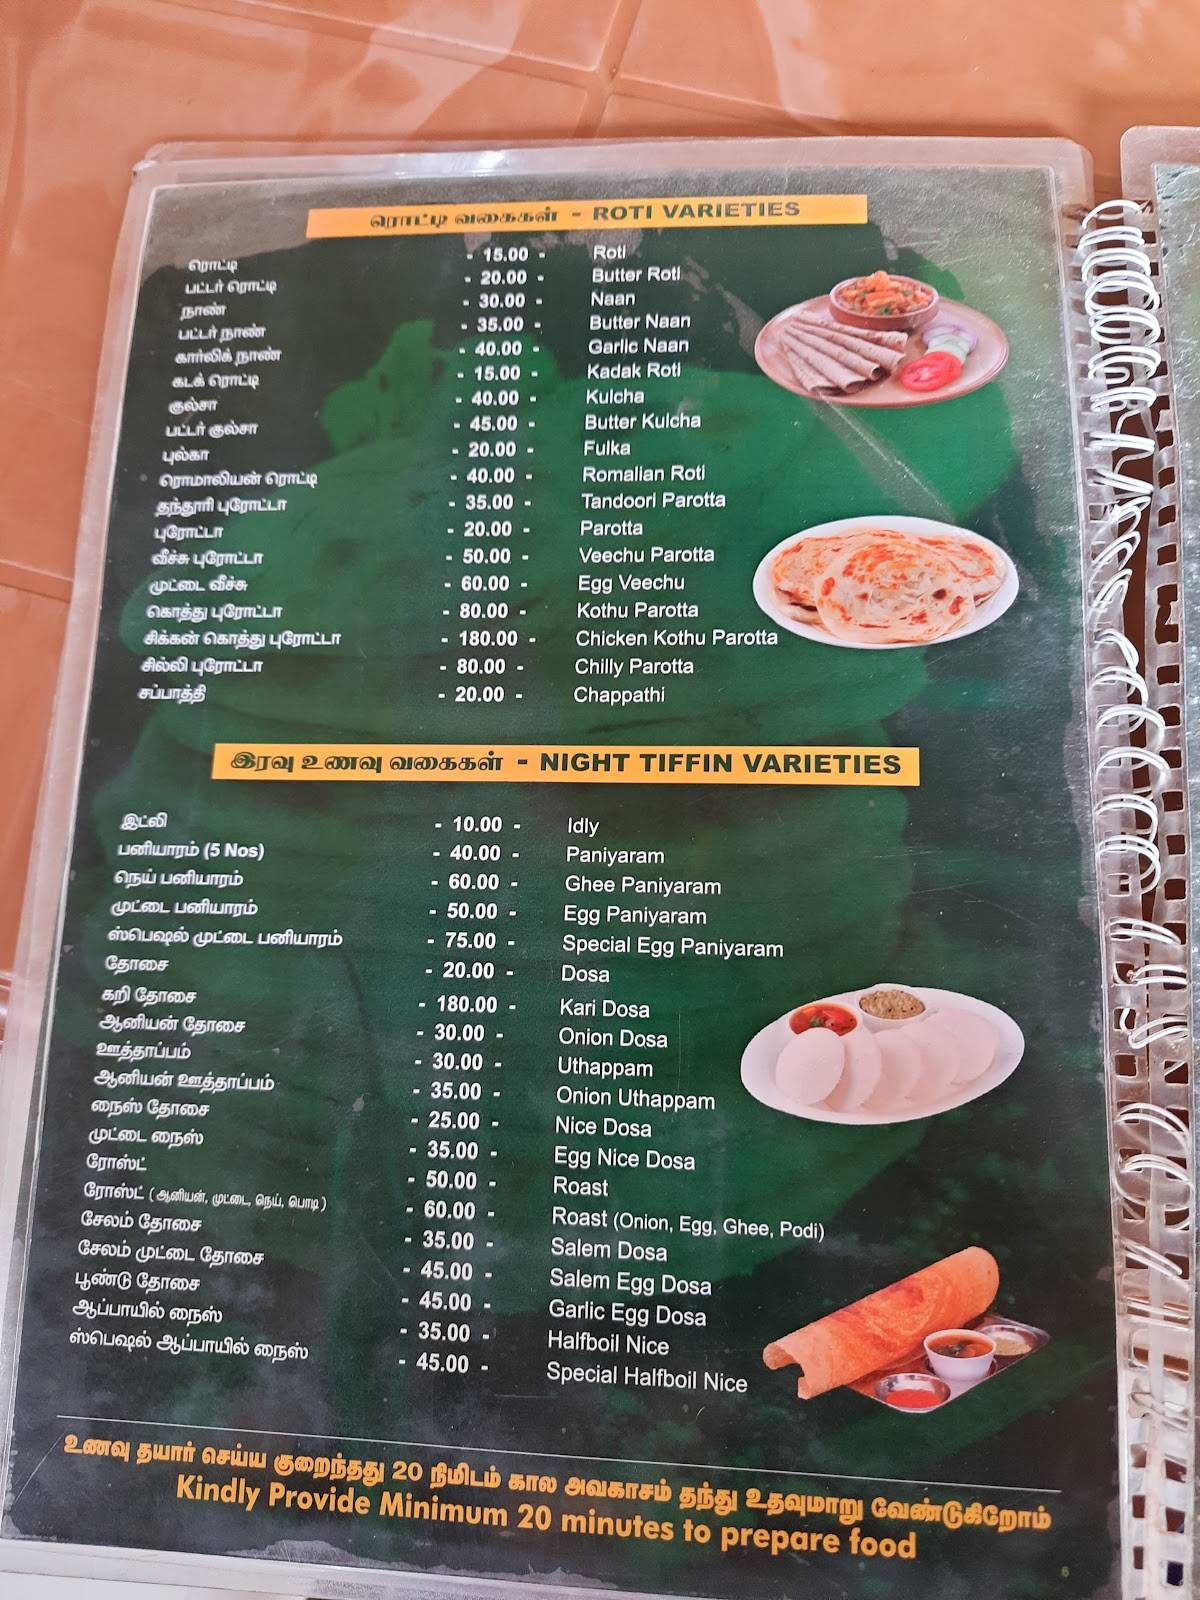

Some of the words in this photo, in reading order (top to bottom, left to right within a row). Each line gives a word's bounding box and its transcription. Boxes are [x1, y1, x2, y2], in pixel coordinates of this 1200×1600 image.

[594, 205, 652, 220] ROTI
[663, 202, 800, 218] VARIETIES
[484, 247, 528, 262] 15.00
[594, 245, 626, 260] Roti
[189, 259, 238, 273] ரொட்டி
[593, 268, 642, 282] Butter
[648, 266, 680, 281] Roti
[481, 270, 527, 285] 20.00
[479, 293, 525, 308] 30.00
[591, 292, 635, 306] Naan
[180, 302, 227, 321] நாண்
[478, 317, 523, 332] 35.00
[590, 315, 640, 330] Butter
[646, 314, 690, 328] Naan
[475, 341, 522, 356] 40.00
[589, 338, 638, 354] Garlic
[644, 338, 688, 353] Naan
[475, 365, 520, 381] 15.00
[588, 363, 641, 379] Kadak
[647, 362, 680, 377] Roti
[472, 391, 519, 406] 40.00
[587, 388, 644, 404] Kulcha
[470, 416, 517, 431] 45.00
[585, 414, 637, 430] Butter
[642, 412, 701, 428] Kulcha
[469, 442, 516, 457] 20.00
[584, 440, 630, 456] Fulka
[467, 468, 514, 483] 40.00
[583, 466, 664, 482] Romalian
[671, 465, 705, 481] Roti
[466, 495, 513, 510] 35.00
[582, 492, 656, 509] Tandoori
[663, 492, 725, 507] Parotta
[155, 524, 223, 543] புரோட்டா
[464, 522, 512, 536] 20.00
[581, 520, 642, 536] Parotta
[463, 548, 510, 564] 50.00
[579, 547, 644, 563] Veechu
[651, 547, 714, 562] Parotta
[462, 576, 509, 591] 60.00
[579, 575, 612, 594] Egg
[619, 574, 684, 590] Veechu
[460, 603, 508, 618] 80.00
[578, 602, 628, 618] Kothu
[635, 602, 698, 617] Parotta
[460, 631, 517, 646] 180.00
[576, 630, 647, 646] Chicken
[654, 630, 705, 645] Kothu
[713, 629, 777, 645] Parotta
[457, 659, 505, 674] 80.00
[575, 658, 624, 677] Chilly
[630, 658, 693, 674] Parotta
[138, 684, 206, 704] சப்பாத்தி
[455, 687, 504, 702] 20.00
[574, 686, 664, 705] Chappathi
[231, 752, 294, 772] இரவு
[302, 756, 382, 773] உணவு
[390, 751, 503, 770] வகைகள்
[541, 753, 630, 772] NIGHT
[640, 754, 732, 772] TIFFIN
[743, 754, 901, 774] VARIETIES
[120, 812, 167, 830] இட்லி
[454, 816, 502, 832] 10.00
[569, 817, 599, 837] Idly
[118, 840, 199, 859] பனியாரம்
[204, 843, 220, 860] (5
[224, 843, 264, 861] Nos)
[450, 845, 500, 861] 40.00
[567, 846, 664, 867] Paniyaram
[449, 874, 499, 890] 60.00
[566, 875, 615, 892] Ghee
[622, 877, 721, 897] Paniyaram
[447, 903, 497, 919] 50.00
[565, 905, 600, 926] Egg
[607, 906, 706, 927] Paniyaram
[446, 932, 496, 949] 75.00
[563, 935, 630, 955] Special
[638, 937, 674, 958] Egg
[682, 938, 783, 959] Paniyaram
[106, 955, 169, 975] தோசை
[443, 962, 494, 979] 20.00
[562, 965, 609, 982] Dosa
[438, 995, 497, 1013] 180.00
[561, 999, 595, 1016] Kari
[603, 1000, 649, 1018] Dosa
[435, 1024, 484, 1041] 30.00
[559, 1027, 613, 1045] Onion
[620, 1029, 667, 1048] Dosa
[433, 1052, 483, 1070] 30.00
[559, 1056, 653, 1079] Uthappam
[431, 1082, 481, 1100] 35.00
[557, 1086, 611, 1105] Onion
[619, 1088, 714, 1111] Uthappam
[429, 1111, 479, 1130] 25.00
[556, 1116, 597, 1134] Nice
[604, 1118, 651, 1137] Dosa
[428, 1140, 478, 1160] 35.00
[555, 1146, 590, 1168] Egg
[598, 1148, 639, 1167] Nice
[647, 1150, 695, 1170] Dosa
[426, 1170, 476, 1189] 50.00
[554, 1176, 608, 1196] Roast
[424, 1200, 475, 1220] 60.00
[81, 1210, 134, 1228] சேலம்
[139, 1213, 202, 1233] தோசை
[553, 1206, 607, 1227] Roast
[614, 1212, 673, 1232] (Onion,
[680, 1216, 716, 1236] Egg,
[723, 1218, 773, 1238] Ghee,
[781, 1221, 824, 1242] Podi)
[423, 1230, 474, 1250] 35.00
[552, 1237, 610, 1258] Salem
[618, 1241, 667, 1261] Dosa
[421, 1260, 472, 1280] 45.00
[550, 1268, 609, 1289] Salem
[617, 1272, 654, 1295] Egg
[662, 1275, 711, 1295] Dosa
[419, 1291, 471, 1311] 45.00
[549, 1299, 605, 1320] Garlic
[612, 1303, 649, 1326] Egg
[657, 1305, 706, 1326] Dosa
[419, 1322, 470, 1342] 35.00
[549, 1330, 619, 1352] Halfboil
[627, 1335, 669, 1355] Nice
[416, 1353, 468, 1373] 45.00
[547, 1361, 617, 1384] Special
[625, 1367, 696, 1389] Halfboil
[704, 1372, 747, 1392] Nice
[64, 1434, 130, 1462] உணவு
[137, 1441, 196, 1464] தயார்
[202, 1443, 266, 1468] செய்ய
[274, 1453, 384, 1485] குறைந்தது
[392, 1461, 423, 1481] 20
[430, 1462, 501, 1489] நிமிடம்
[508, 1474, 557, 1493] கால
[565, 1477, 672, 1501] அவகாசம்
[679, 1482, 737, 1514] தந்து
[746, 1488, 863, 1525] உதவுமாறு
[871, 1497, 1051, 1532] வேண்டுகிறோம்
[177, 1474, 260, 1510] Kindly
[269, 1482, 370, 1514] Provide
[380, 1491, 507, 1526] Minimum
[518, 1504, 551, 1530] 20
[562, 1509, 673, 1540] minutes
[683, 1519, 711, 1543] to
[722, 1527, 840, 1553] prepare
[849, 1527, 916, 1558] food
